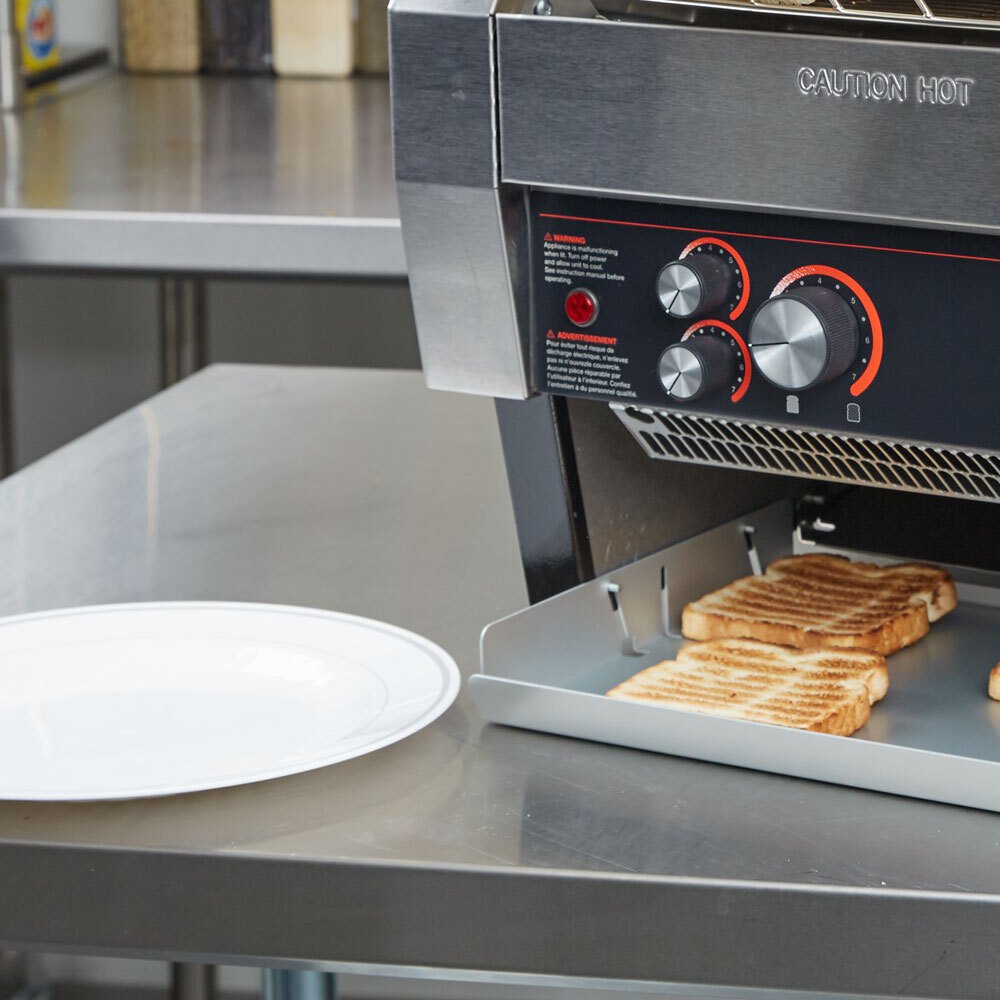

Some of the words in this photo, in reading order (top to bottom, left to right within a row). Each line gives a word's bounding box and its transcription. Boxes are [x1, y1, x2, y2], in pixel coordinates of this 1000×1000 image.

[797, 66, 907, 102] CAUTION
[917, 75, 975, 107] HOT
[553, 234, 586, 244] WARNING
[544, 242, 571, 250] Appliance
[578, 246, 618, 256] malfunctioning
[556, 268, 585, 276] instruction
[607, 273, 625, 281] before
[851, 297, 856, 305] 5
[865, 336, 870, 344] 6
[546, 339, 559, 347] Pour
[589, 345, 606, 353] risque
[547, 364, 567, 373] Aucune
[609, 380, 631, 389] Confiez
[588, 386, 615, 395] personnel
